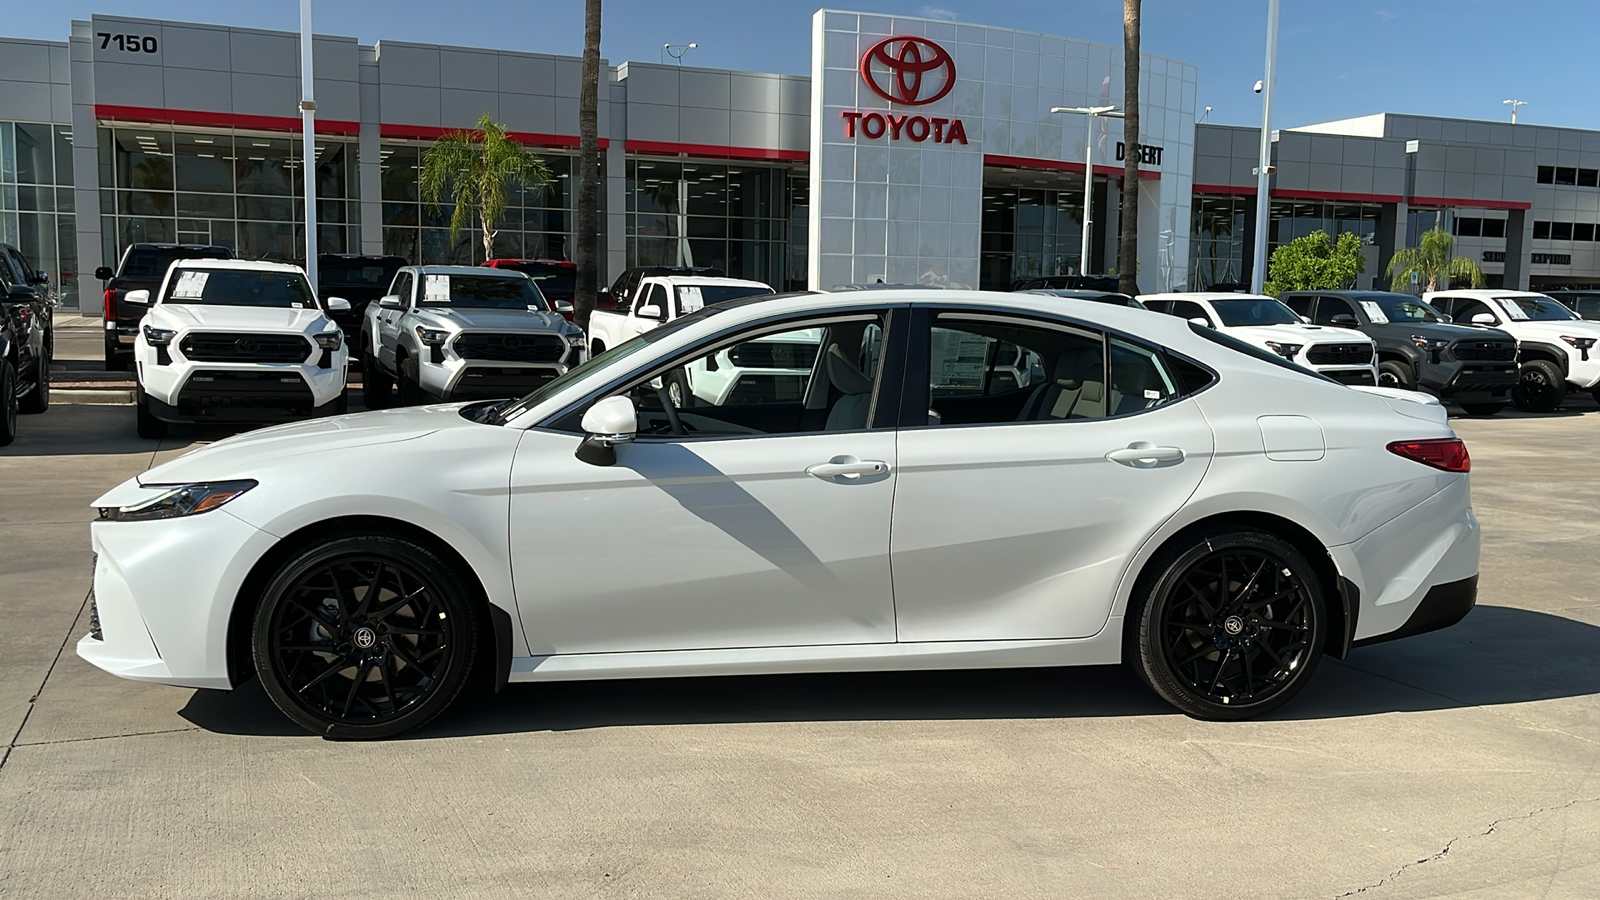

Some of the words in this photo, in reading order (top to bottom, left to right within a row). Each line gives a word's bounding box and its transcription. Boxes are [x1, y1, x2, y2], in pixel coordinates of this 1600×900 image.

[97, 32, 158, 54] 7150
[840, 111, 968, 145] TOYOTA
[1115, 141, 1164, 166] DSERT
